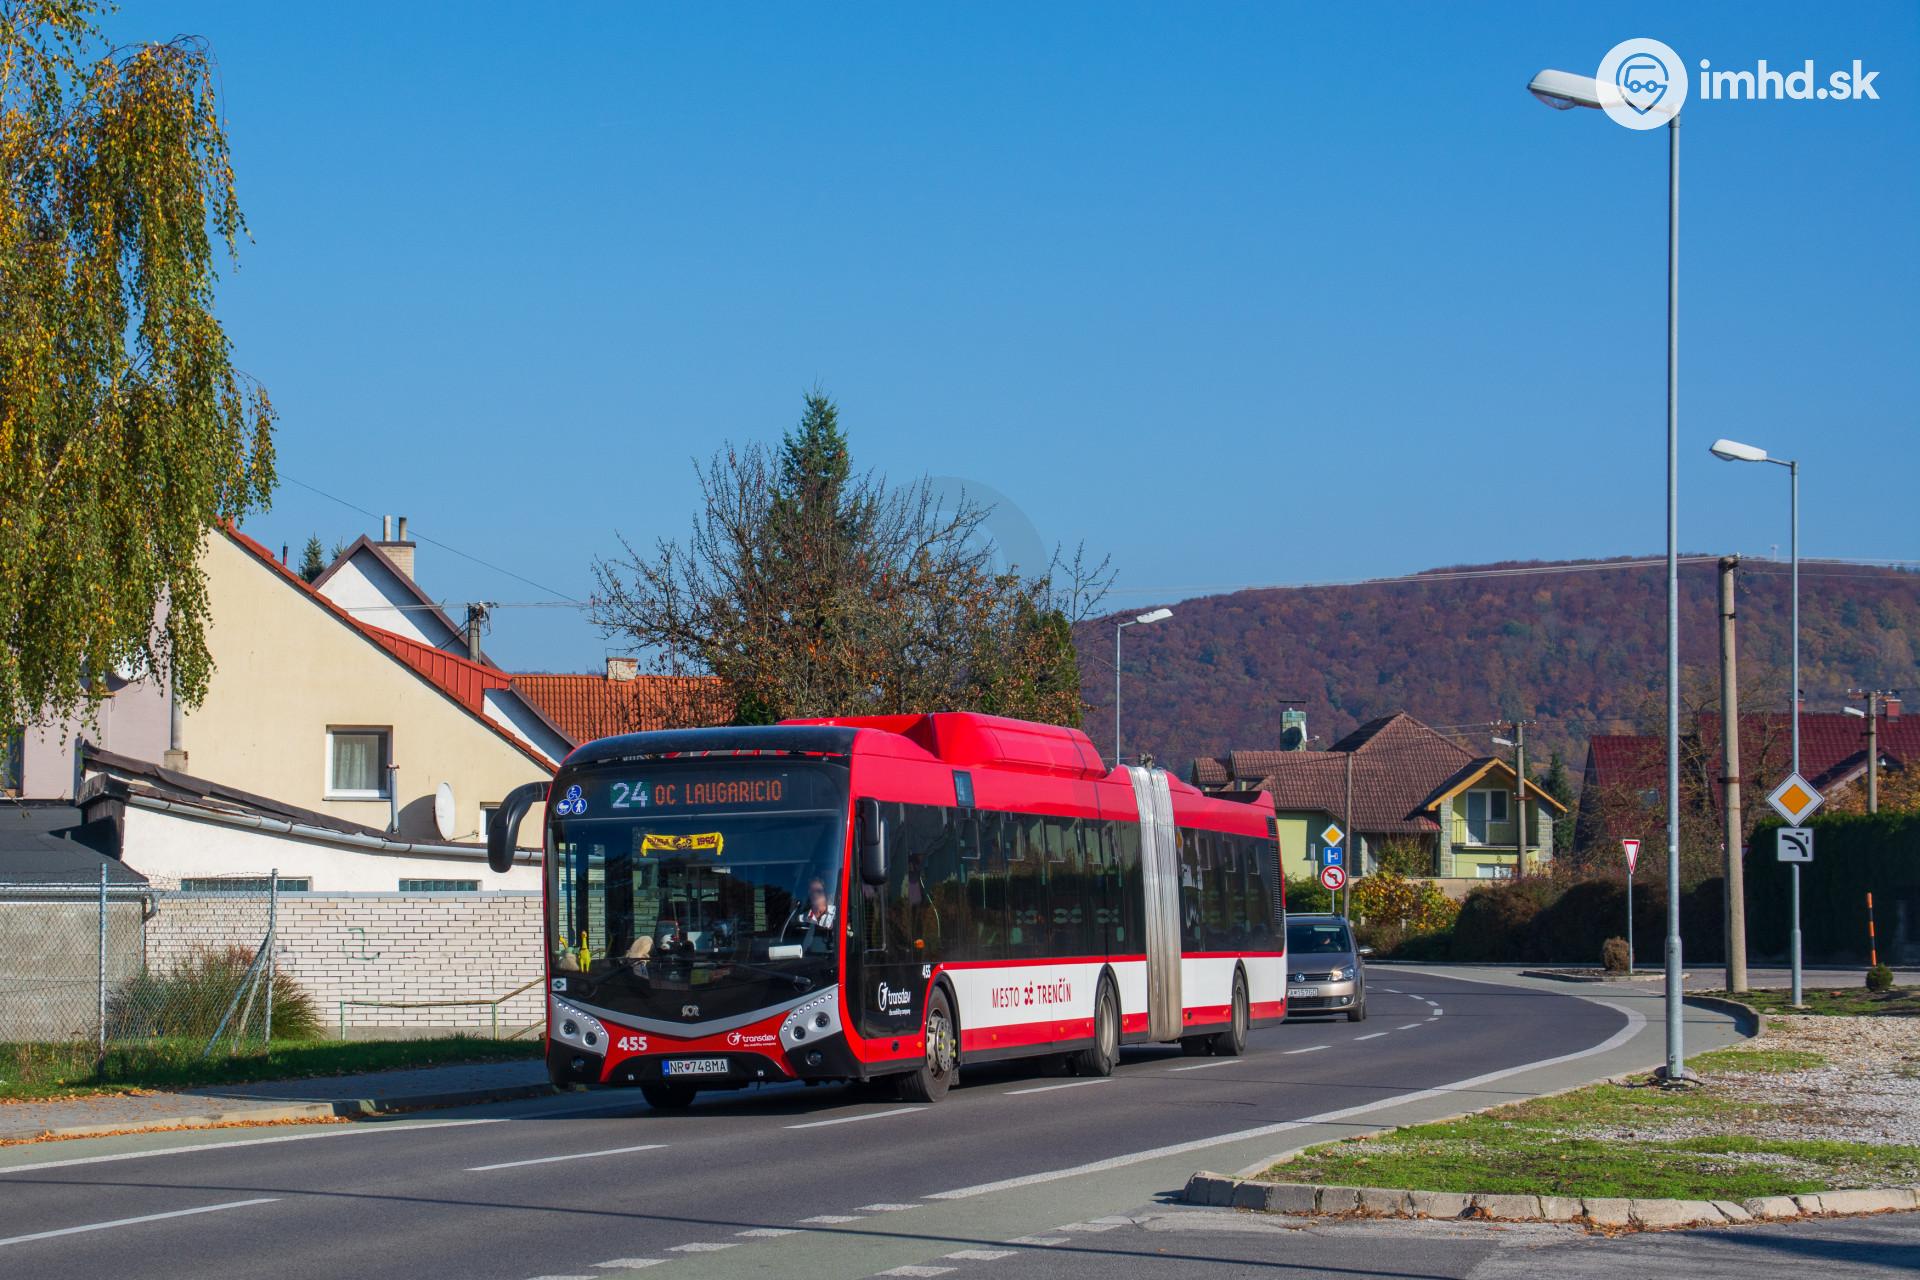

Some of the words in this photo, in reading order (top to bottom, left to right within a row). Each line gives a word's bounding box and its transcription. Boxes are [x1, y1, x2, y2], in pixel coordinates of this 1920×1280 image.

[612, 780, 648, 808] 24
[655, 784, 675, 806] OC
[684, 779, 782, 805] LAUGARICIO
[922, 964, 931, 979] 455
[992, 986, 1020, 1008] MESTO
[1037, 978, 1072, 1005] TRENČÍN
[617, 1036, 648, 1051] 455
[742, 1033, 777, 1043] transdev
[690, 1060, 727, 1072] 748MA
